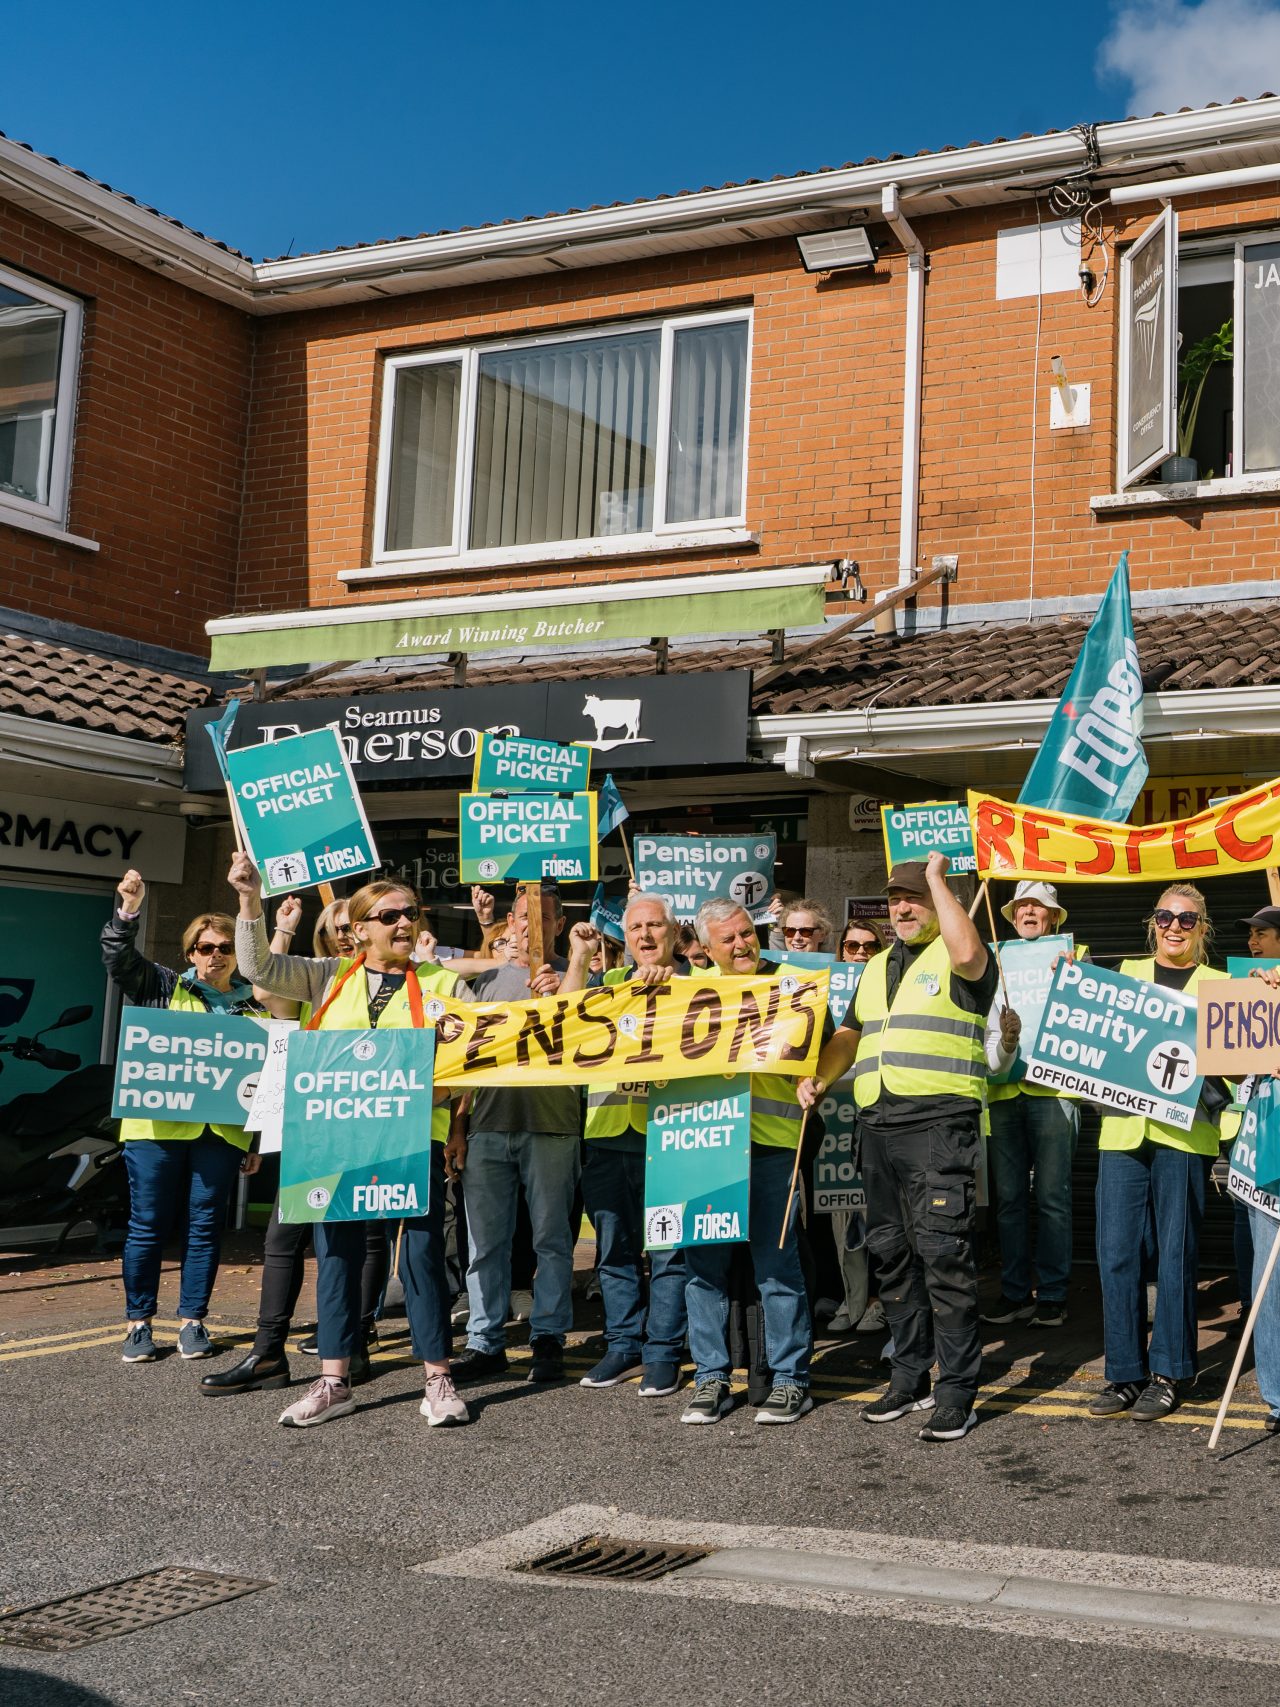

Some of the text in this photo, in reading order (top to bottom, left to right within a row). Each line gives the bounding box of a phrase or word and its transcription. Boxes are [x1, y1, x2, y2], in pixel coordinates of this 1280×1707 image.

[1133, 275, 1153, 300] FIANNA
[1132, 402, 1162, 433] CONSTITUENCY
[1140, 419, 1155, 436] OFFICE
[395, 618, 605, 649] Award Winning Butcher
[344, 704, 442, 729] Seamus
[488, 740, 583, 767] OFFICIAL
[240, 762, 341, 801] OFFICIAL
[496, 759, 573, 783] PICKET
[256, 783, 334, 818] PICKET
[468, 801, 583, 821] OFFICIAL
[480, 823, 571, 843] PICKET
[890, 809, 969, 830] OFFICIA
[902, 826, 970, 847] PICKET
[313, 845, 366, 876] FÓRSA
[541, 853, 583, 877] FÓRSA
[638, 840, 748, 863] Pension
[639, 865, 722, 891] parity
[664, 894, 696, 910] ow
[1055, 962, 1187, 1028] Pension
[435, 979, 818, 1070] PENSIONS
[1045, 1001, 1148, 1053] parity
[124, 1026, 265, 1061] Pension
[1038, 1029, 1108, 1071] now
[122, 1058, 233, 1091] parity
[293, 1069, 425, 1094] OFFICIAL
[119, 1088, 195, 1111] now
[305, 1096, 411, 1121] PICKET
[1031, 1065, 1189, 1126] OFFICIAL PICKET FÓRSA
[653, 1098, 744, 1126] OFFICIAL
[661, 1125, 735, 1152] PICKET
[352, 1175, 418, 1213] FÓRSA
[818, 1193, 866, 1207] OFFICI
[693, 1204, 741, 1241] FÓRSA
